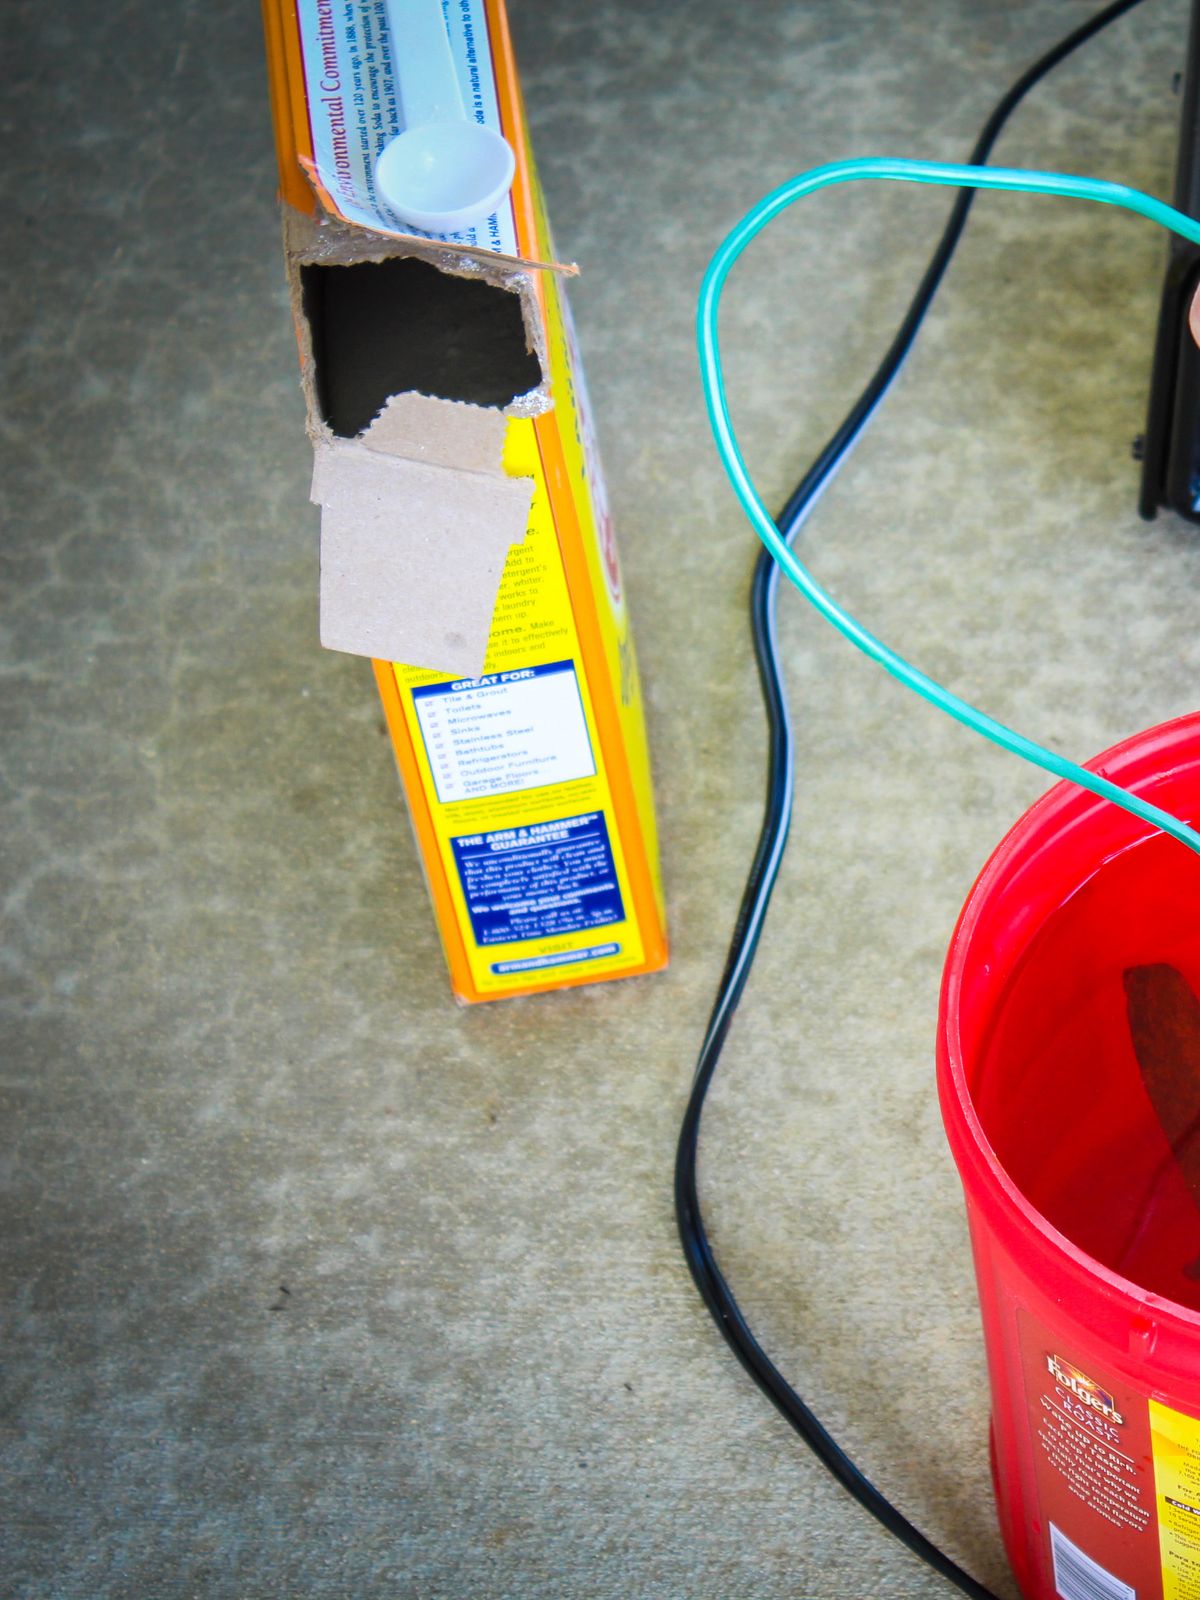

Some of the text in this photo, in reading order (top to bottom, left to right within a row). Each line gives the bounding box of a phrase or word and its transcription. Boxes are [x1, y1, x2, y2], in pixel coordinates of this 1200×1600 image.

[343, 3, 353, 22] when
[374, 2, 385, 15] 100
[377, 16, 390, 31] past
[461, 14, 471, 22] to
[362, 15, 376, 50] protection
[377, 33, 388, 44] the
[348, 45, 358, 53] in
[462, 24, 477, 63] alternative
[364, 52, 375, 63] the
[381, 46, 391, 60] over
[380, 62, 392, 75] and
[353, 72, 365, 91] years
[368, 65, 380, 100] encourage
[467, 65, 480, 92] natural
[353, 93, 364, 106] 120
[387, 98, 396, 106] as
[357, 109, 367, 124] over
[371, 113, 383, 130] Soda
[385, 107, 399, 124] back
[356, 126, 369, 150] started
[501, 590, 527, 600] works
[502, 599, 536, 611] laundry
[530, 619, 554, 629] Make
[511, 628, 568, 645] to effectively
[494, 642, 546, 657] indoors and
[451, 670, 535, 690] GREAT FOR:
[476, 687, 508, 698] Grout
[445, 703, 482, 713] Toilets
[448, 710, 511, 724] Microwaves
[450, 726, 481, 735] Sinks
[453, 727, 534, 745] Stainless Steel
[455, 744, 505, 756] Bathtubs
[457, 750, 529, 765] Refrigerators
[460, 755, 557, 777] Outdoor Furniture
[463, 769, 539, 787] Garage Floors
[464, 785, 487, 793] AND
[457, 835, 483, 847] THE
[486, 830, 517, 843] ARM
[518, 829, 528, 838] &
[490, 829, 570, 851] GUARANTEE
[1046, 1355, 1124, 1425] Folgers
[1055, 1386, 1119, 1438] CLASSIC
[1040, 1397, 1072, 1430] Wake
[1075, 1430, 1091, 1445] up
[1094, 1443, 1106, 1455] to
[1043, 1417, 1140, 1494] Each cup is important
[1060, 1424, 1121, 1473] Pure Taste
[1047, 1431, 1138, 1501] to That's why we
[1051, 1452, 1148, 1525] the right temperature
[1068, 1485, 1086, 1501] and
[1078, 1467, 1102, 1486] roast
[1103, 1486, 1126, 1503] each
[1127, 1500, 1150, 1518] bean
[1177, 1484, 1192, 1495] For
[1058, 1467, 1091, 1496] release
[1092, 1495, 1111, 1511] rich
[1112, 1509, 1144, 1532] flavors
[1171, 1500, 1191, 1511] Cold
[1168, 1550, 1189, 1562] Para
